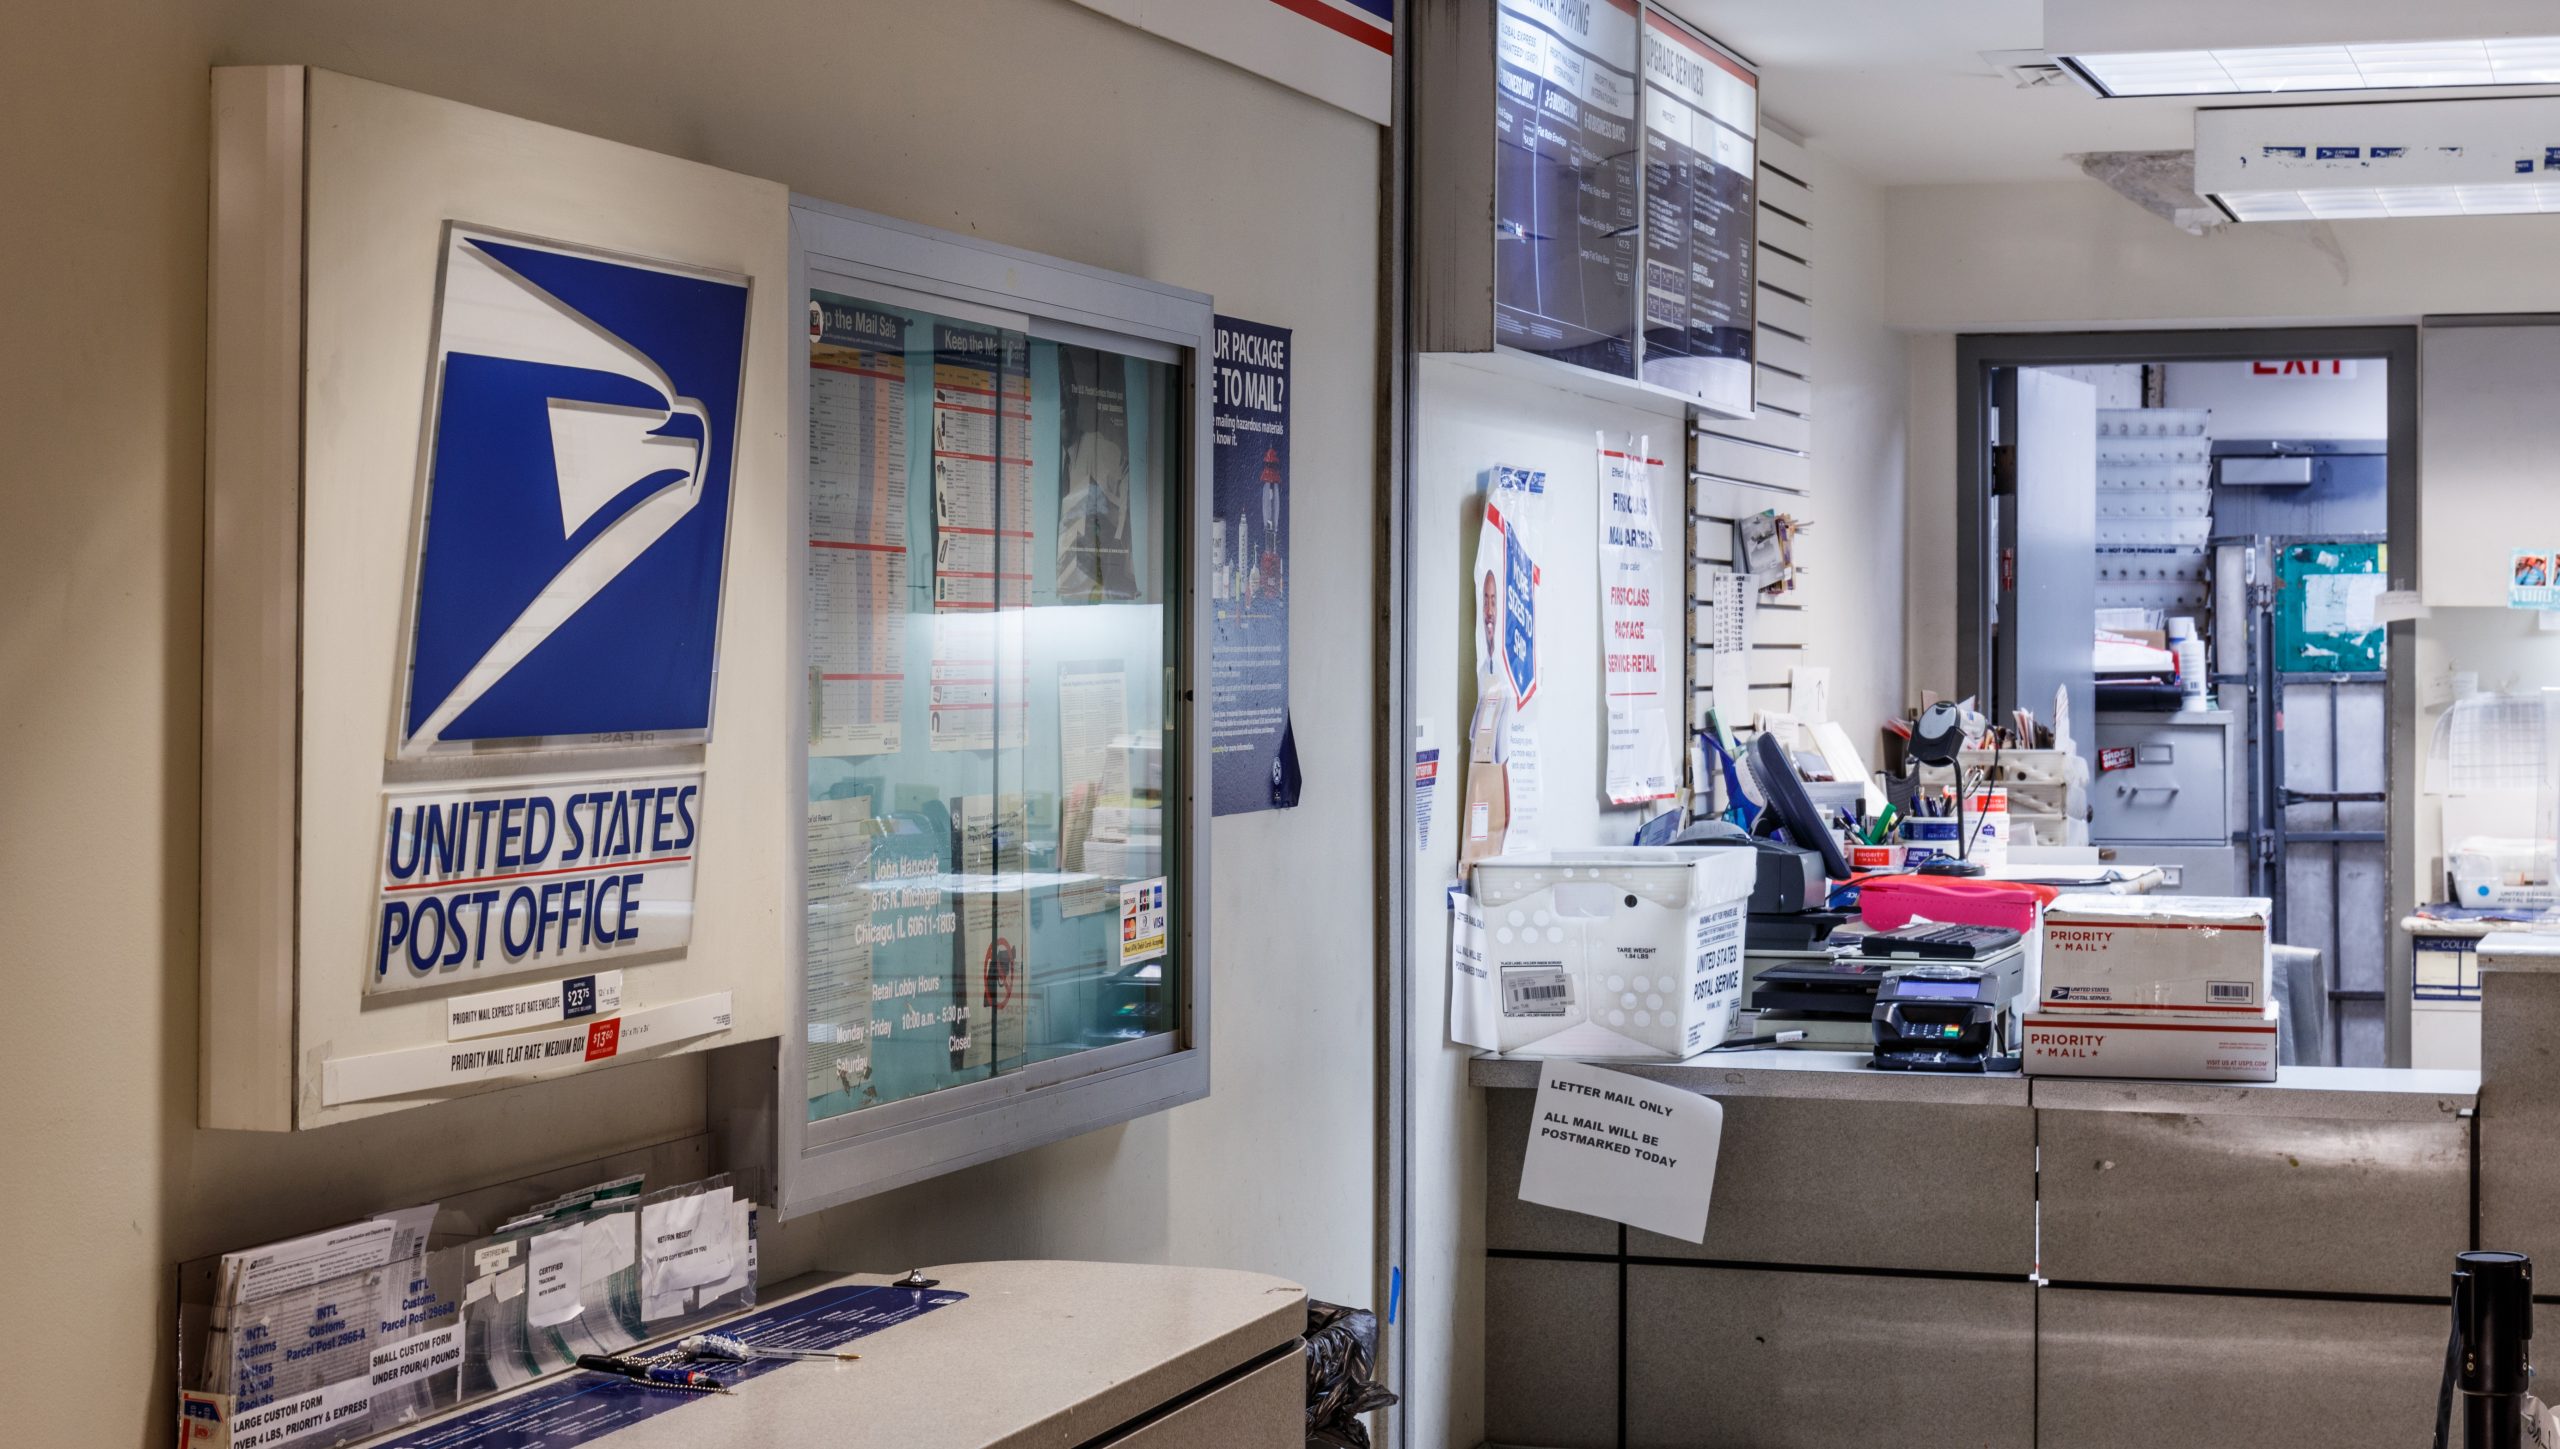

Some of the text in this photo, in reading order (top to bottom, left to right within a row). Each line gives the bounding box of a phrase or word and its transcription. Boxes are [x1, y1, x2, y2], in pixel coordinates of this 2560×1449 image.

[1675, 52, 1704, 96] SERVICES
[834, 308, 852, 330] the
[856, 312, 877, 334] Mail
[880, 316, 896, 338] Safe
[945, 329, 983, 355] Keep the
[1213, 328, 1284, 370] UR PACKAGE
[1222, 368, 1241, 407] TO
[1245, 373, 1284, 413] MAIL?
[1215, 415, 1284, 435] mailing hazardous materials
[1216, 431, 1229, 445] know
[1508, 584, 1533, 638] SIZES TO
[1611, 586, 1649, 607] FIRST-CLASS
[1513, 627, 1527, 663] SHIP
[1615, 621, 1644, 640] PACKAGE
[389, 785, 697, 880] UNITED STATES
[875, 862, 898, 881] John
[379, 873, 644, 975] POST OFFICE
[855, 912, 956, 946] Chicago, IL 60611-1803
[1153, 916, 1164, 928] VISA
[2051, 931, 2112, 942] PRIORITY
[1634, 947, 1656, 955] WEIGHT
[1696, 944, 1738, 974] UNITED STATES
[872, 976, 939, 1001] Retail Lobby Hours
[1694, 970, 1738, 1001] POSTAL SERVICE
[452, 1009, 477, 1025] PRIORITY
[478, 1007, 491, 1020] MAIL
[515, 1002, 527, 1016] FLAT
[527, 1000, 538, 1014] RATE
[538, 995, 560, 1012] ENVELOPE
[836, 1005, 971, 1045] Monday Friday 10:00 a.m. 5:30 p.m.
[452, 1051, 486, 1072] PRIORITY
[487, 1049, 504, 1066] MAIL
[506, 1046, 523, 1063] FLAT
[544, 1039, 572, 1058] MEDIUM
[573, 1036, 586, 1053] BOX
[2031, 1034, 2104, 1045] PRIORITY
[2048, 1048, 2086, 1058] MAIL
[836, 1034, 971, 1076] Saturday Closed
[1550, 1079, 1673, 1117] LETTER MAIL ONLY
[1544, 1112, 1659, 1146] ALL MAIL WILL BE
[1541, 1127, 1677, 1168] POSTMARKED TODAY
[539, 1262, 564, 1276] CERTIFIED
[539, 1275, 556, 1284] TRACKING
[402, 1293, 436, 1311] Customs
[548, 1283, 566, 1294] SIGNATURE
[309, 1319, 346, 1338] Customs
[381, 1315, 407, 1333] Parcel
[409, 1311, 427, 1325] Post
[239, 1341, 277, 1361] Customs
[286, 1328, 366, 1362] Parcel Post 2966-A
[372, 1332, 452, 1367] SMALL CUSTOM FORM
[240, 1362, 273, 1381] Letters
[372, 1347, 460, 1386] UNDER FOUR(4) POUNDS
[240, 1385, 246, 1397] &
[233, 1395, 323, 1434] LARGE CUSTOM FORM
[233, 1399, 368, 1449] OVER 4 LBS, PRIORITY & EXPRESS
